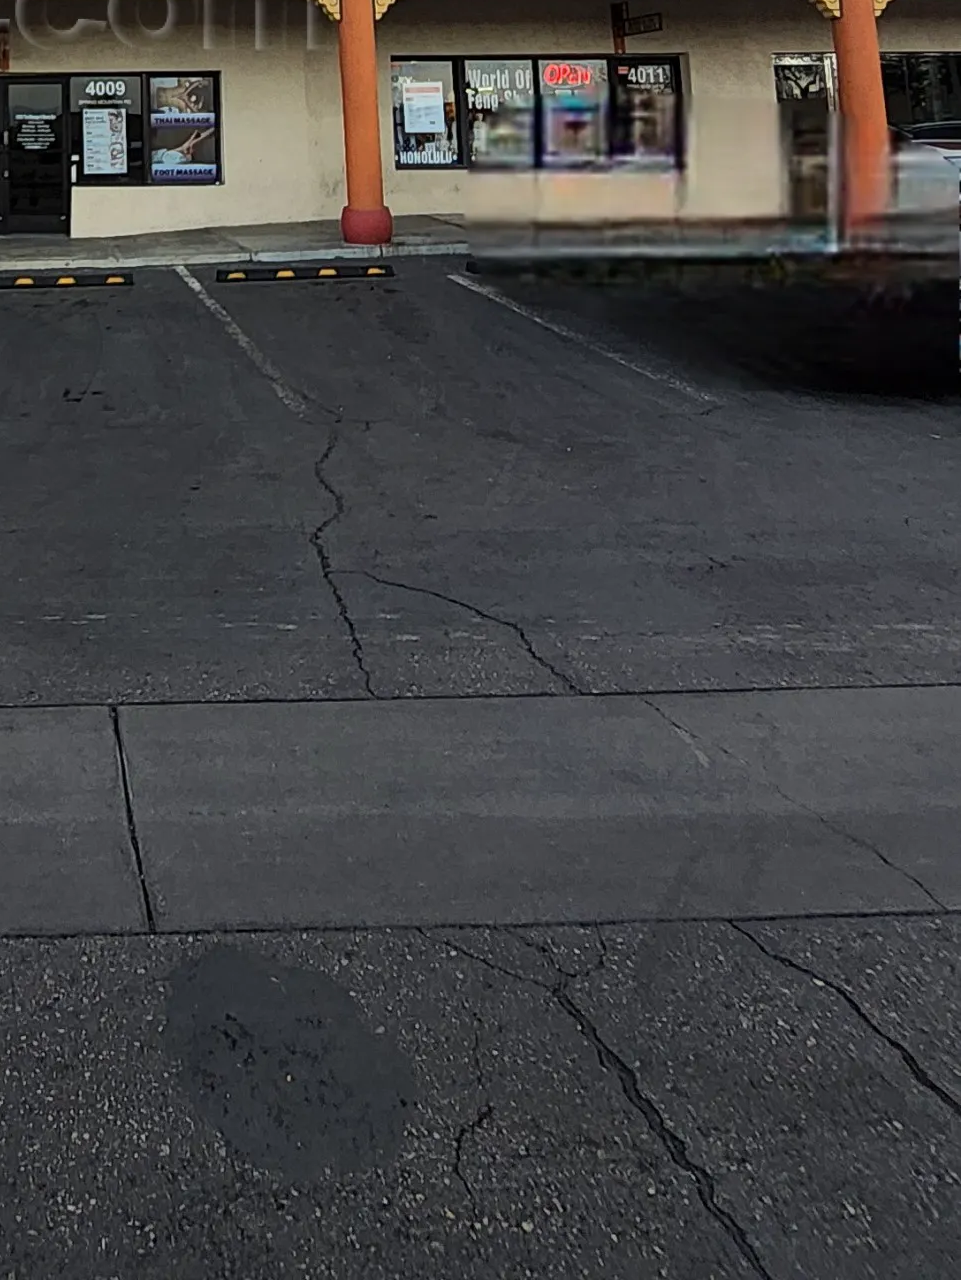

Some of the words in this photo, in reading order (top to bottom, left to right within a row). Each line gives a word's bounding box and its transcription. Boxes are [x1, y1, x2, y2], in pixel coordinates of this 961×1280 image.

[467, 68, 509, 89] World
[515, 68, 531, 89] Of
[627, 67, 664, 83] 4011
[85, 81, 126, 96] 4009
[400, 150, 453, 164] HONOLULU
